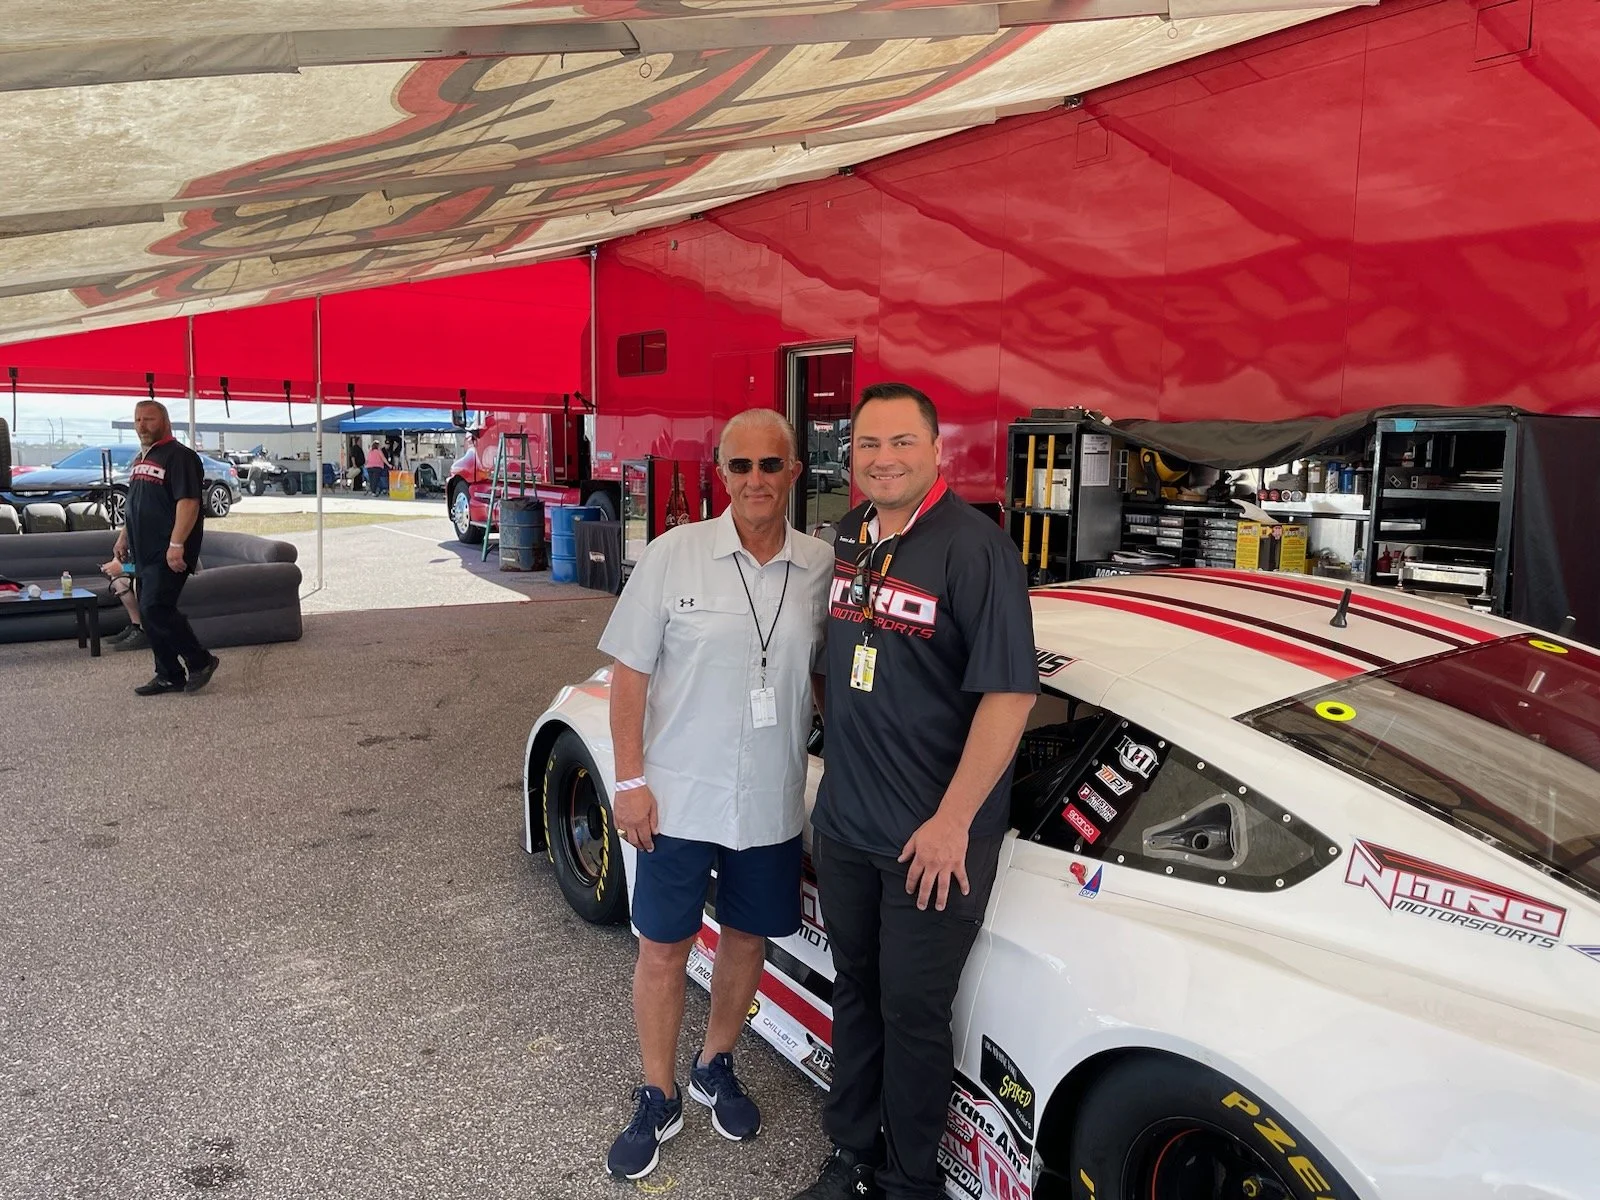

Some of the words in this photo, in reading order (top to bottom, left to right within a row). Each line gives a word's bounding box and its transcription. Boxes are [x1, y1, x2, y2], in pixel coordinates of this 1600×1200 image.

[832, 607, 936, 639] MOTOSPORTS
[1068, 809, 1095, 837] sparco
[1081, 889, 1096, 897] OFF
[1345, 839, 1567, 937] NITRO
[1395, 899, 1559, 949] MOTORSPORTS
[999, 1074, 1032, 1109] SPIKED
[950, 1091, 996, 1138] rans
[995, 1131, 1022, 1175] Am
